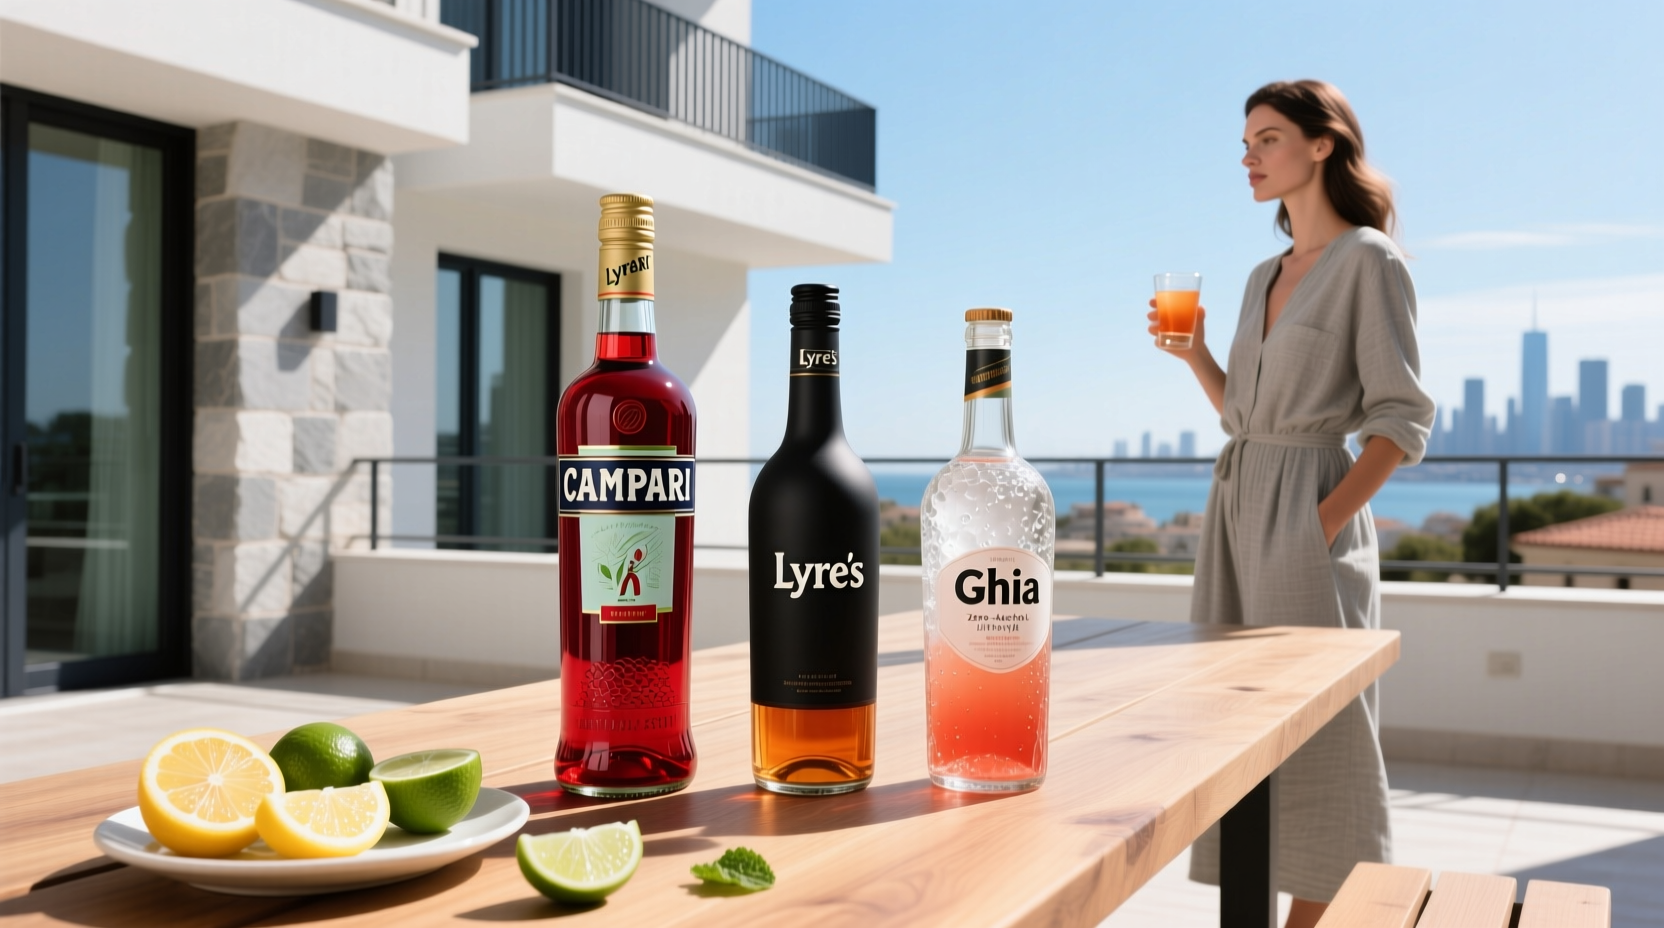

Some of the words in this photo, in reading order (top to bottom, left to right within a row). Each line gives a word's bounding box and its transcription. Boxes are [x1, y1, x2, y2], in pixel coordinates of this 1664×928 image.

[799, 348, 838, 369] Lyre's
[563, 467, 691, 502] CAMPARI
[773, 551, 865, 599] Lyre's
[954, 567, 1040, 605] Ghia
